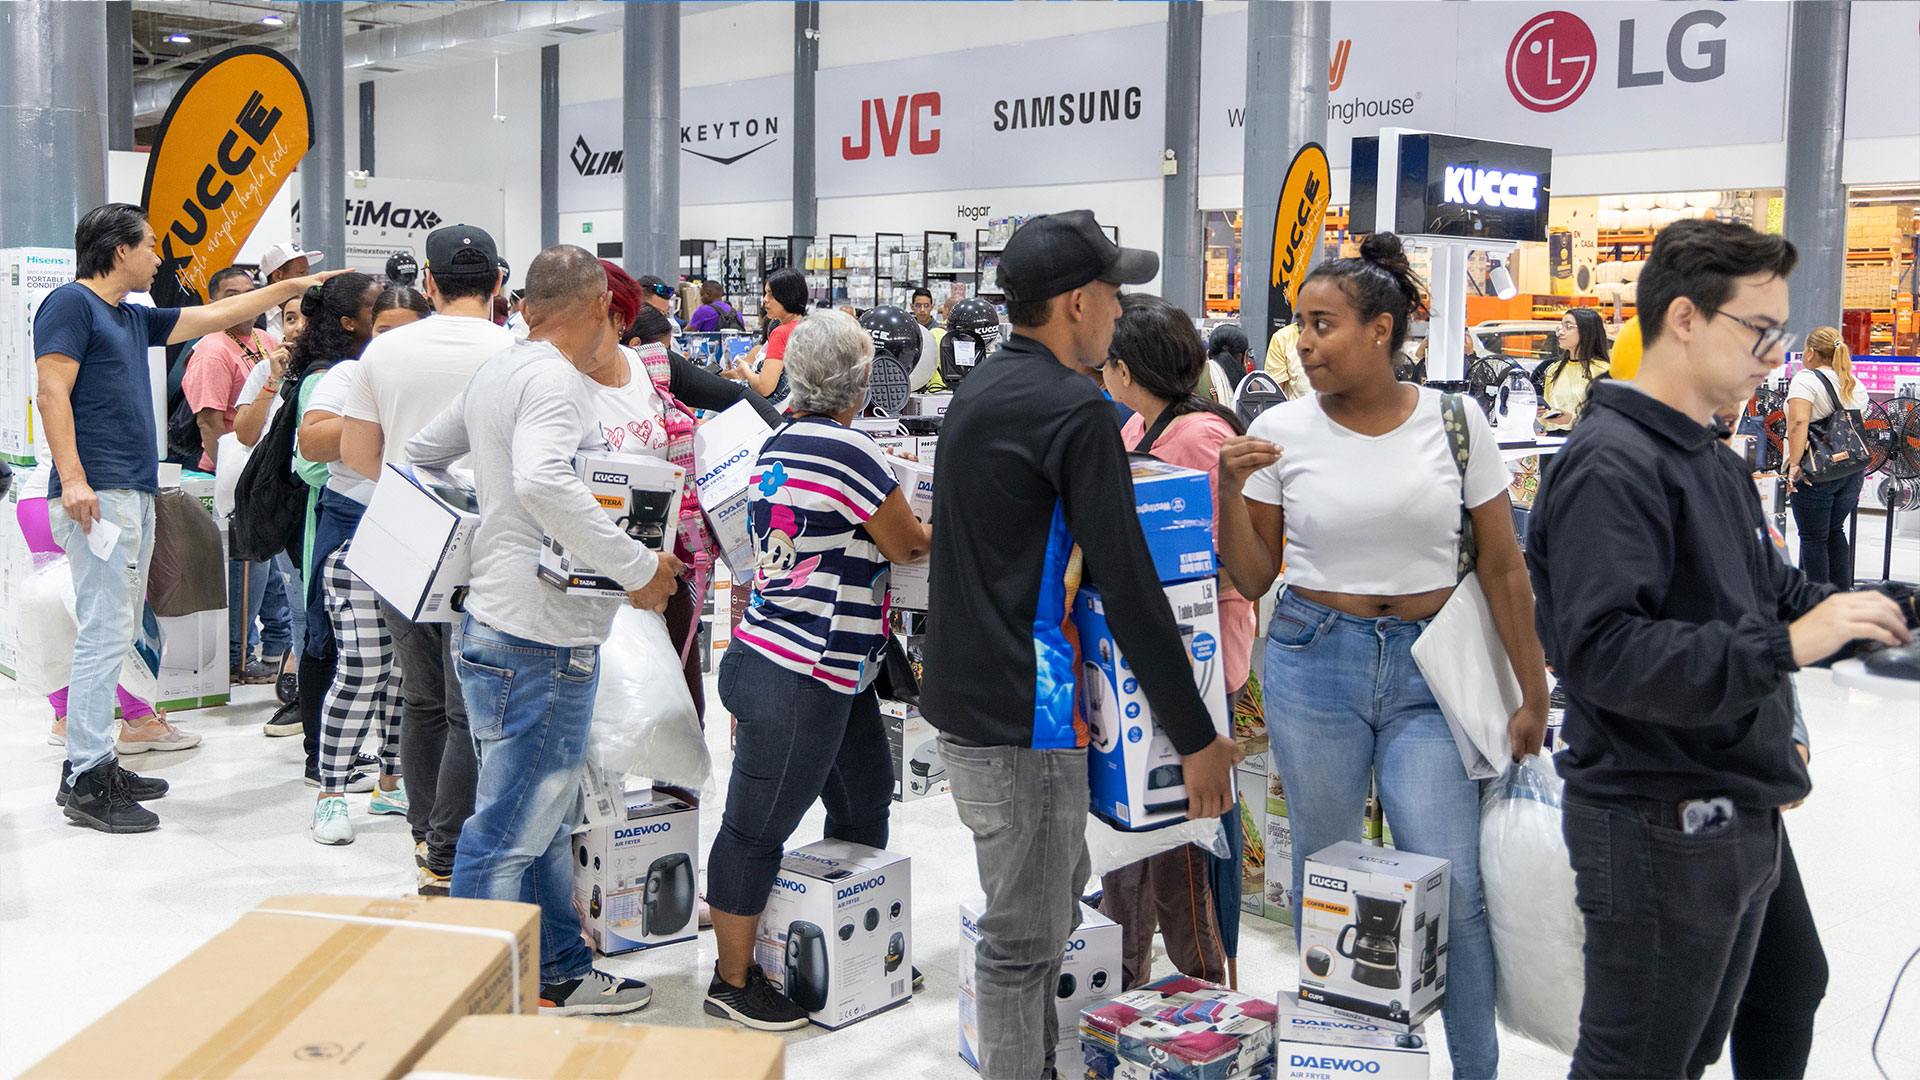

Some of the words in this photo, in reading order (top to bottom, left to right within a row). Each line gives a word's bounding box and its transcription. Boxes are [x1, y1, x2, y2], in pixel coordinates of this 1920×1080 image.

[1617, 10, 1727, 88] LG
[994, 86, 1142, 131] SAMSUNG
[1228, 97, 1414, 127] Winghouse
[681, 116, 779, 143] KEYTON
[842, 92, 942, 161] JVC
[570, 134, 624, 176] OLIM
[161, 90, 283, 272] KUCCE
[1444, 165, 1538, 210] KUCCE
[957, 204, 991, 221] Hogar
[1276, 170, 1321, 288] KUCCE
[26, 256, 71, 264] Hisense
[696, 449, 749, 486] DAEWOO
[594, 473, 627, 484] KUCCE
[917, 481, 934, 492] DAE
[597, 498, 623, 506] ETERA
[718, 496, 748, 518] DAE
[1178, 604, 1193, 620] Table
[1193, 600, 1214, 617] Blender
[615, 822, 671, 839] DAEWOO
[789, 851, 840, 867] DAEWOO
[773, 877, 806, 894] EWOO
[837, 875, 886, 900] DAEWOO
[1311, 876, 1346, 890] KUCCE
[838, 900, 846, 908] AIR
[846, 896, 860, 906] FRYER
[1308, 993, 1324, 1001] CUPS
[1292, 1018, 1379, 1031] DAEWOO
[1291, 1055, 1380, 1073] DAEWOO
[1305, 1072, 1331, 1080] FRYER
